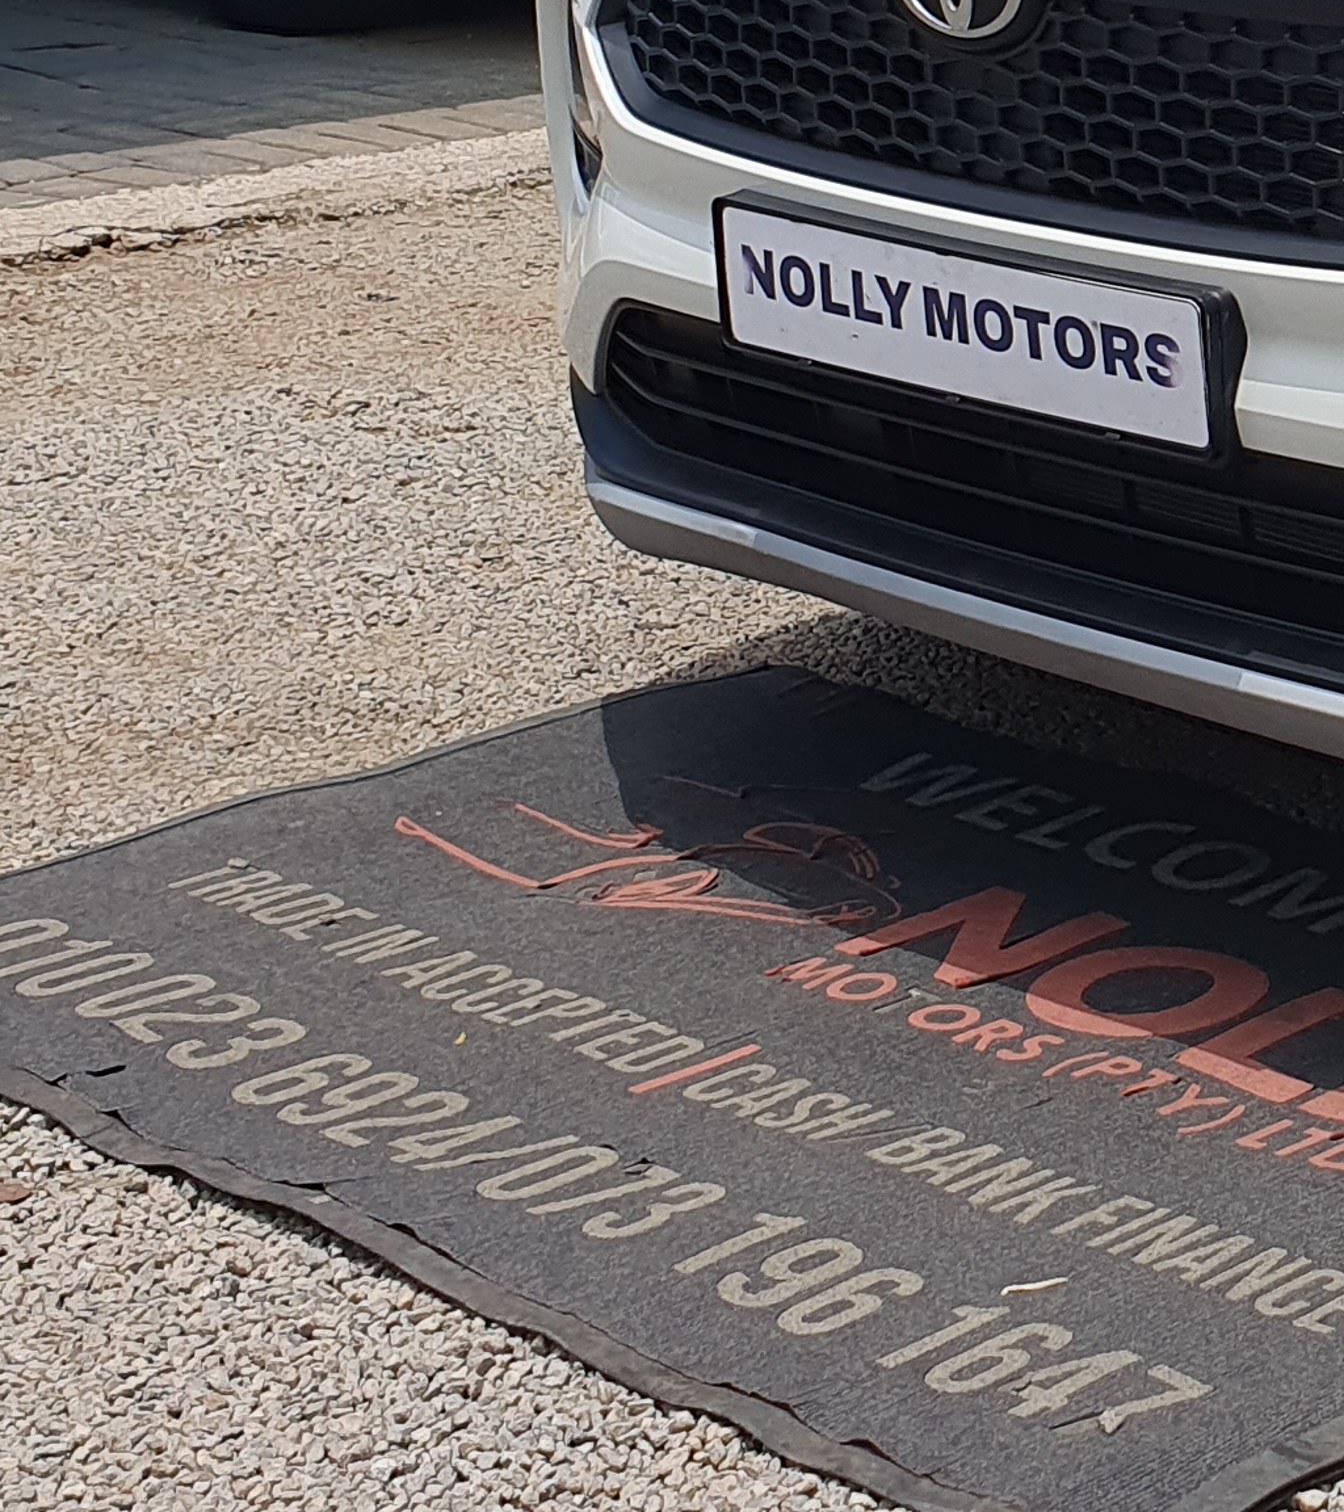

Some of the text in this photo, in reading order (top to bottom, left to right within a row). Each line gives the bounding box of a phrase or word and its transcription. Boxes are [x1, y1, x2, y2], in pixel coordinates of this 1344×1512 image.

[741, 244, 1181, 388] NOLLY MOTORS
[168, 857, 378, 940] TRADE
[322, 924, 439, 963] IN
[1042, 1051, 1245, 1135] (PTY)
[673, 1212, 924, 1336] 196
[875, 1305, 1214, 1434] 1647
